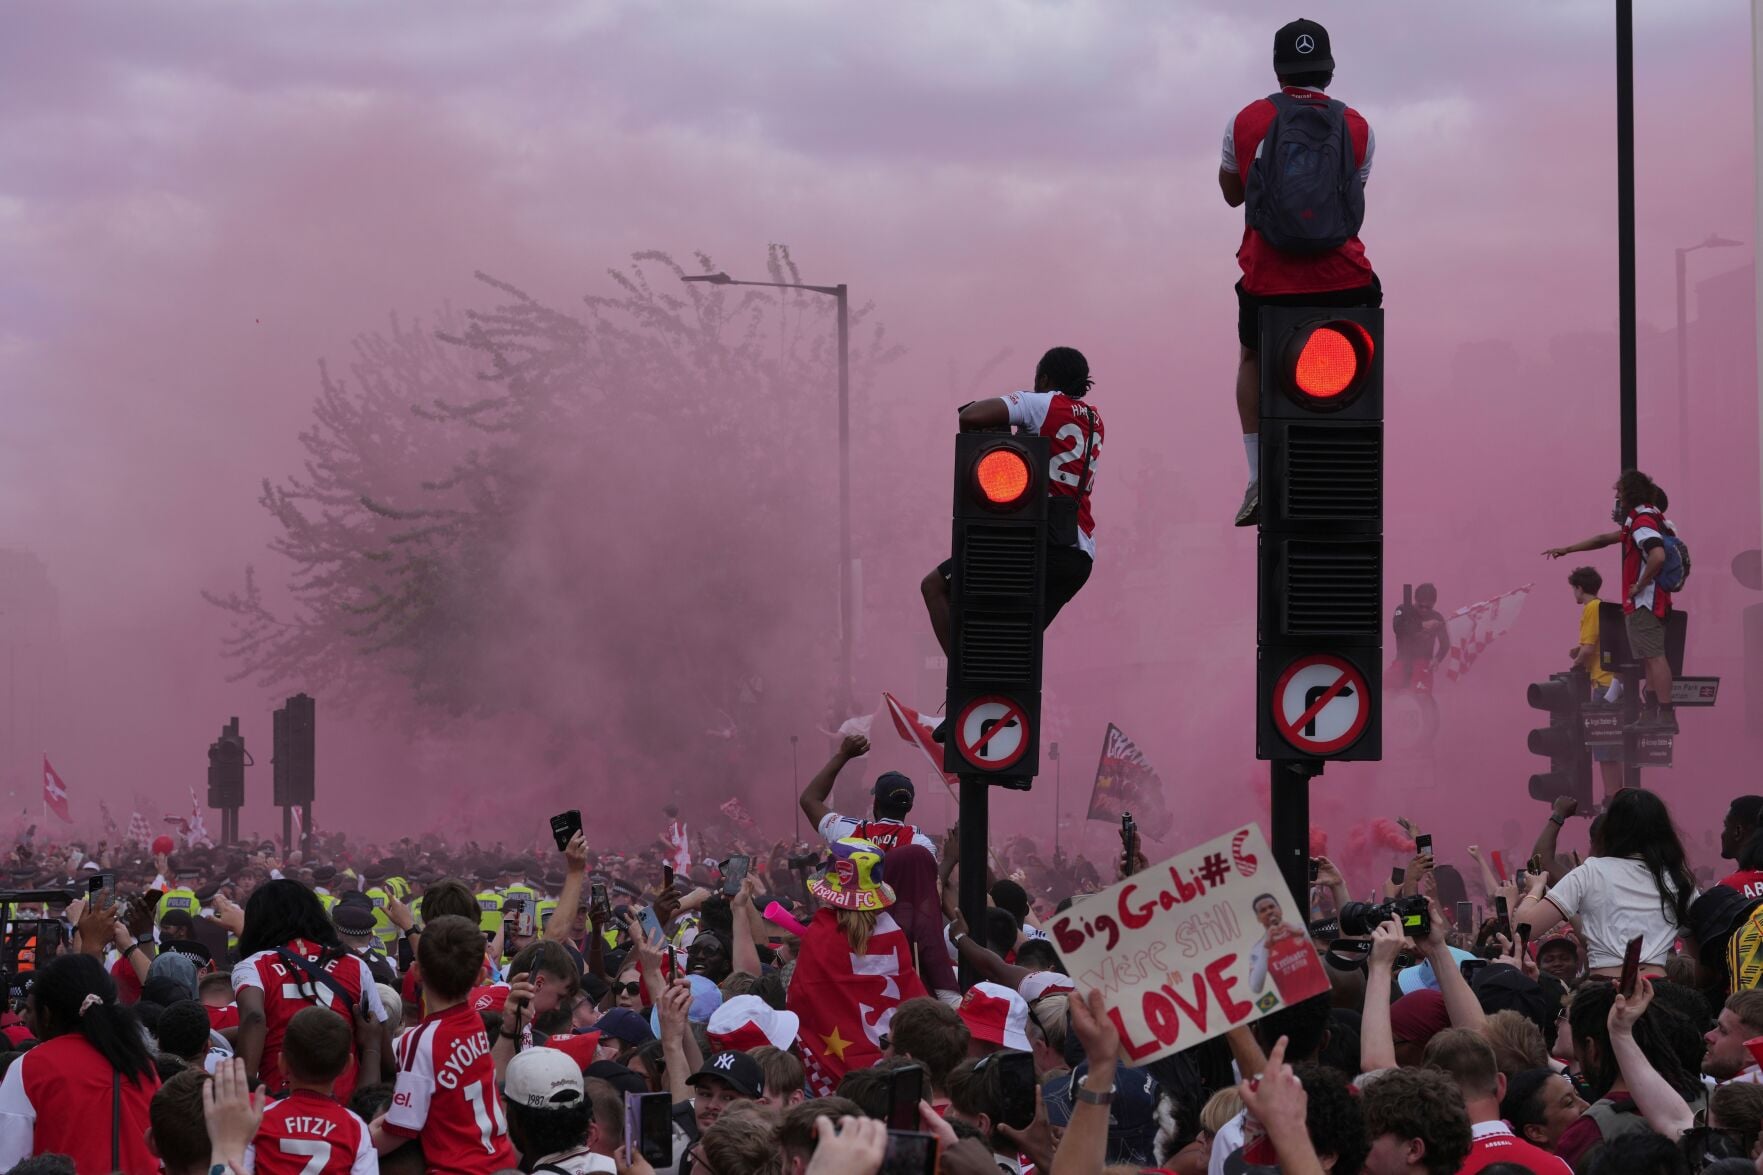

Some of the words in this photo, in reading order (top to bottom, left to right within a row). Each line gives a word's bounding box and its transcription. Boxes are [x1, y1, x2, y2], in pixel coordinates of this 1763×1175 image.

[1049, 423, 1103, 492] 29
[167, 898, 191, 907] POLICE
[812, 879, 850, 906] Arsenal
[855, 891, 876, 907] FC
[1107, 953, 1253, 1062] LOVE
[713, 1053, 736, 1071] NY
[393, 1092, 412, 1108] el.
[528, 1094, 545, 1106] 1987
[284, 1116, 337, 1137] FITZY
[279, 1138, 333, 1175] 7
